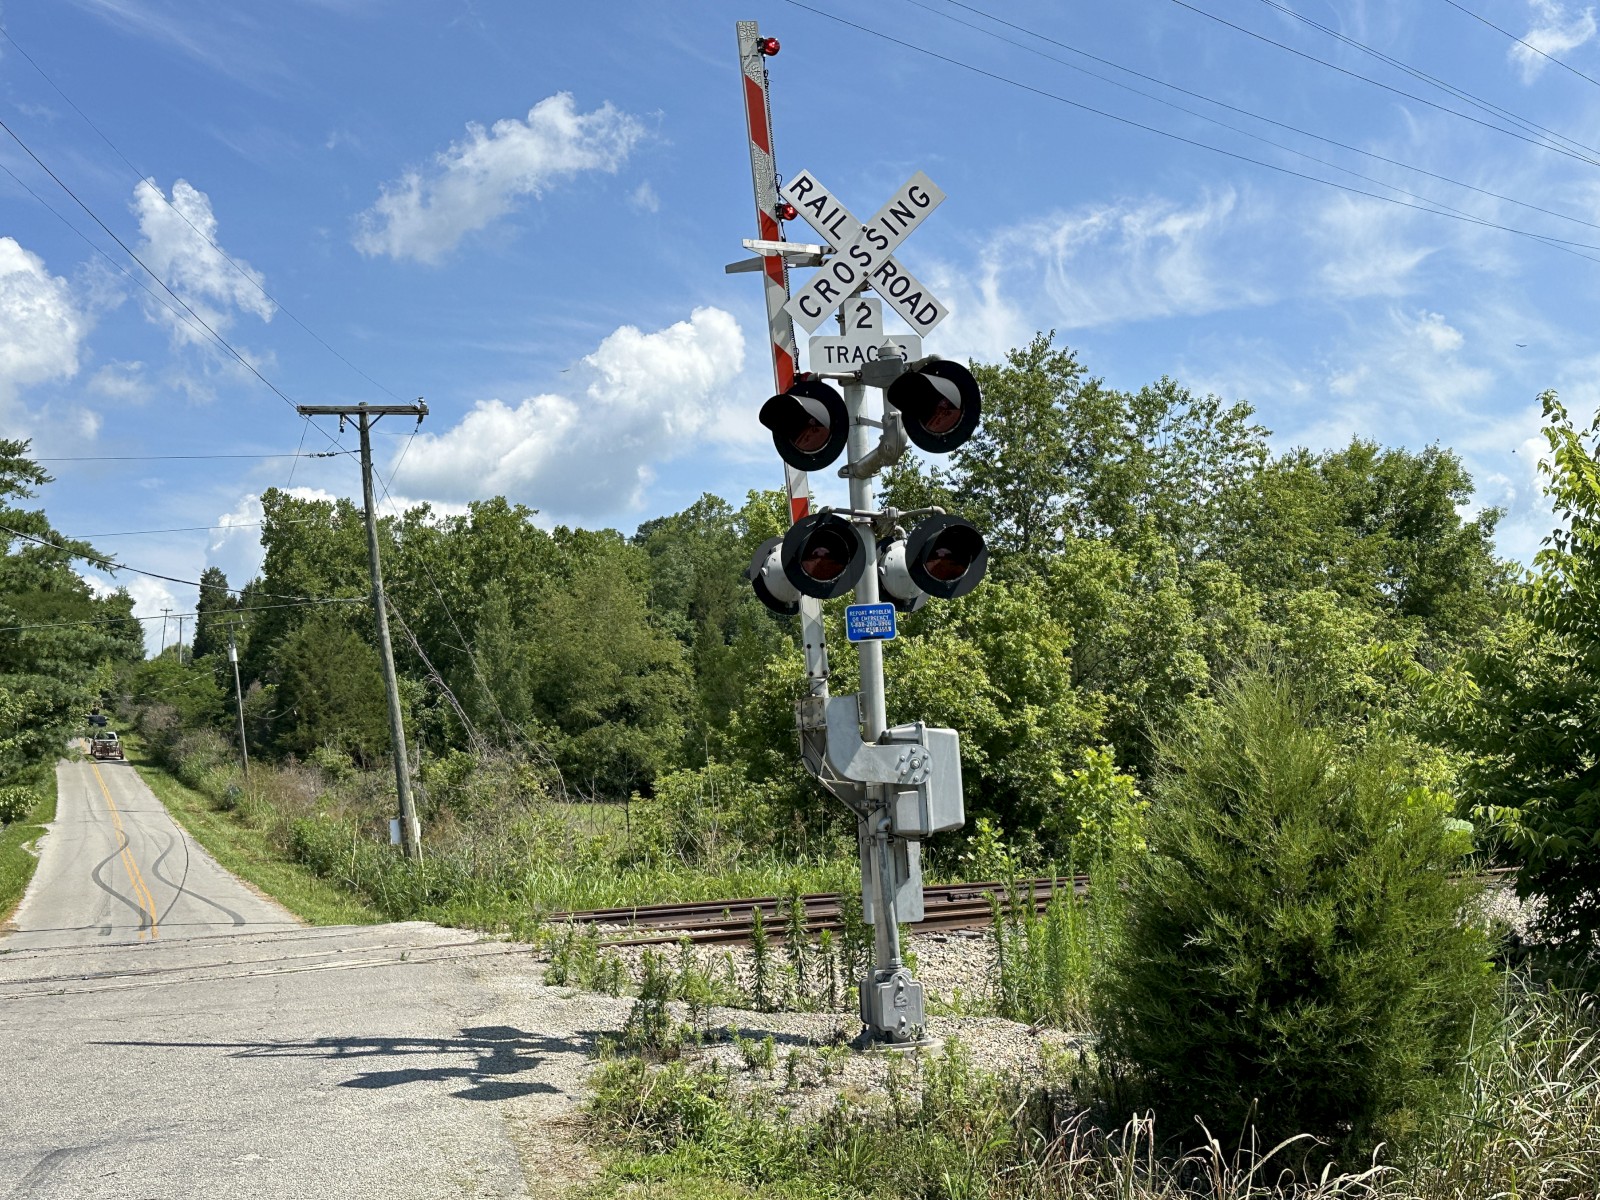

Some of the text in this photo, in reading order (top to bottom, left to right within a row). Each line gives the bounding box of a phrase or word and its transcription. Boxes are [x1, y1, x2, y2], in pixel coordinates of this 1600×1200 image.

[789, 175, 938, 326] RAIL ROAD
[799, 185, 930, 318] CROSSING
[824, 345, 908, 364] TRACS
[856, 305, 873, 329] 2
